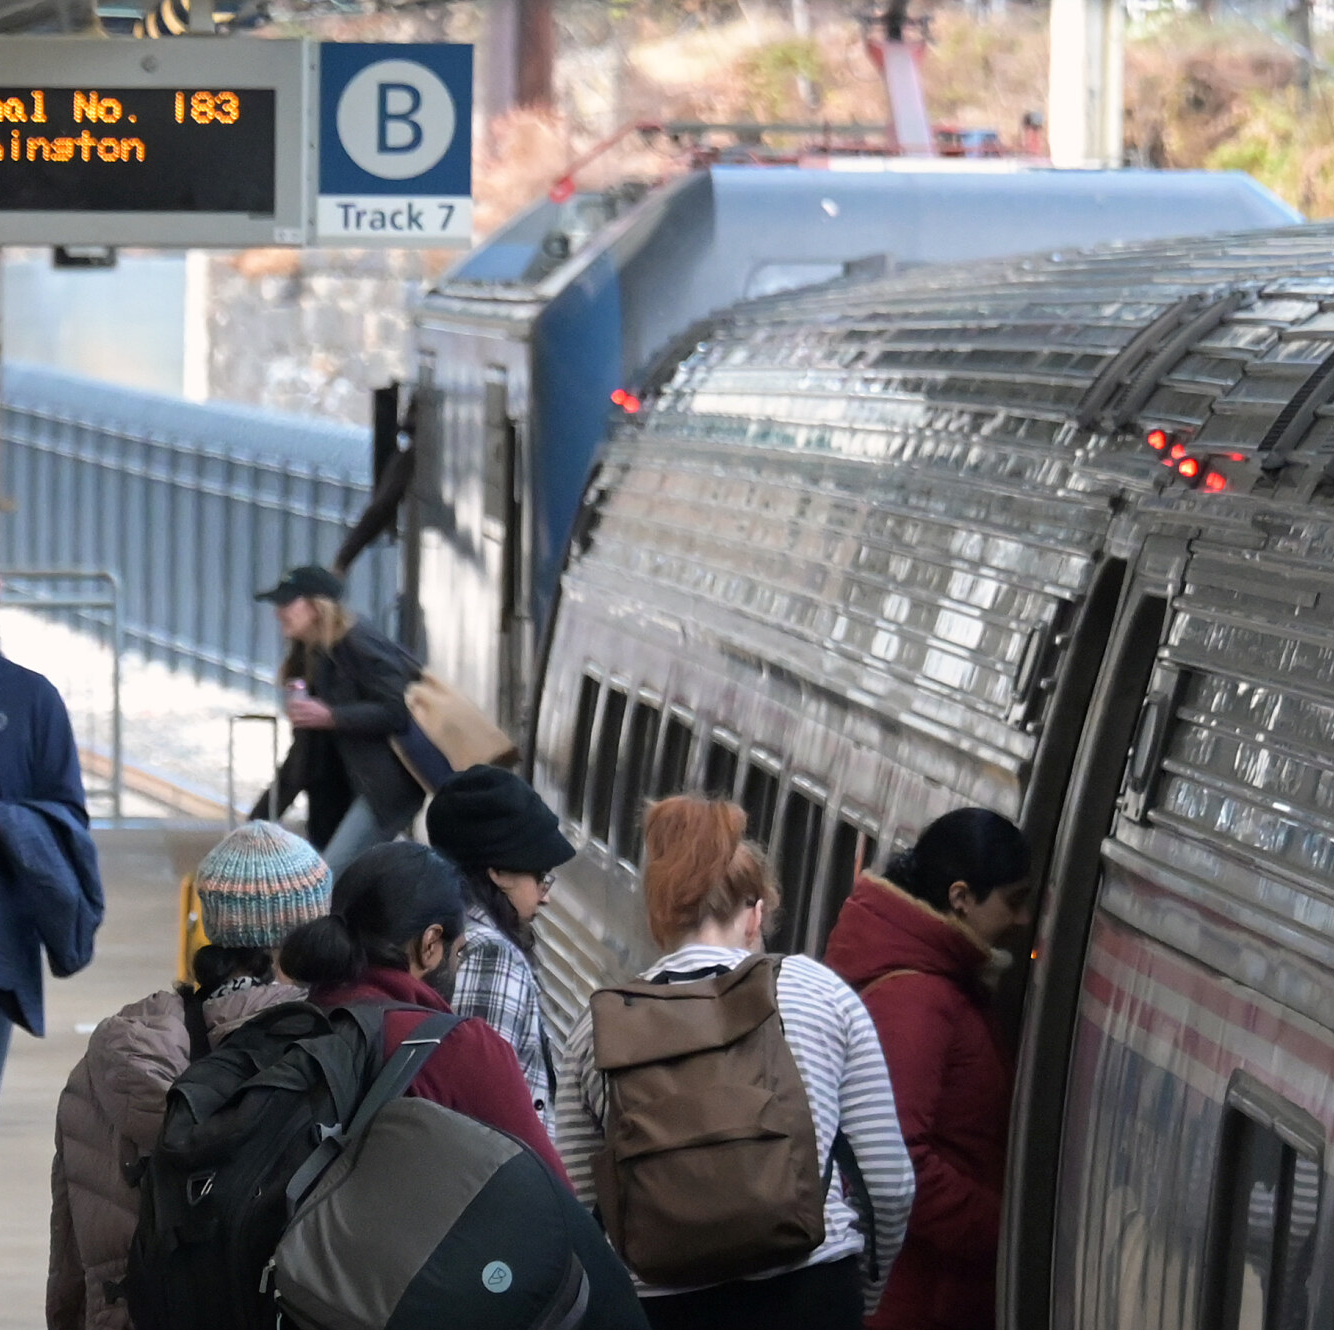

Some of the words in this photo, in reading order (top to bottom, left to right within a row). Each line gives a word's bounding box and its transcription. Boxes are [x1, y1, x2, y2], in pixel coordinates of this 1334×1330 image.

[73, 90, 138, 124] No.
[174, 90, 240, 125] 183
[377, 81, 424, 154] B
[336, 202, 425, 231] Track
[438, 204, 456, 231] 7
